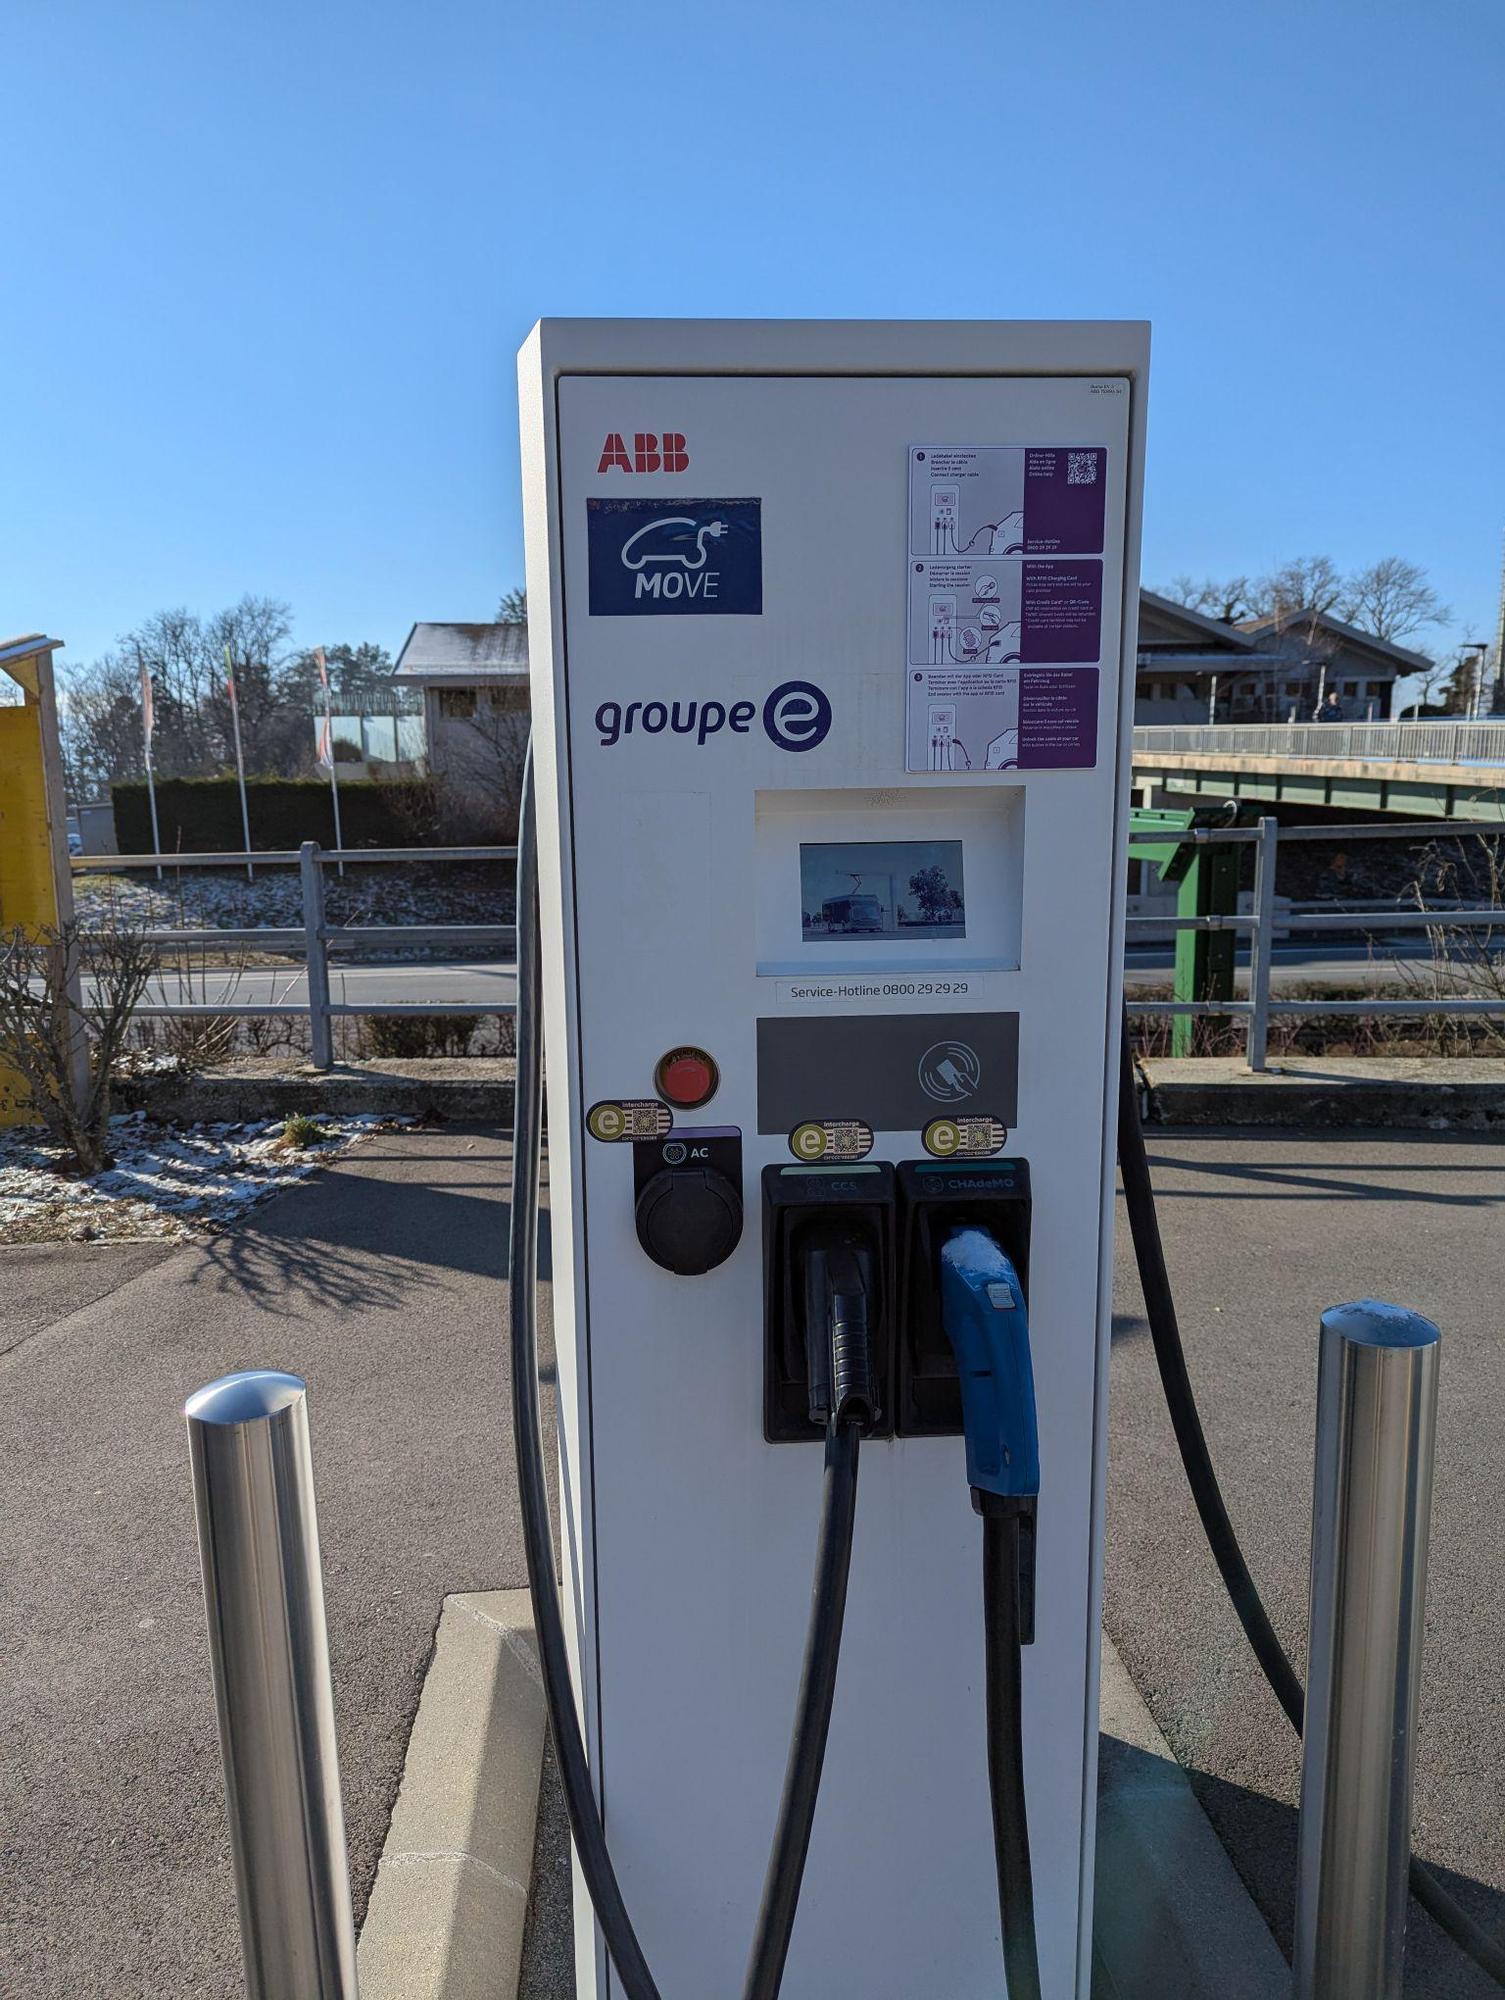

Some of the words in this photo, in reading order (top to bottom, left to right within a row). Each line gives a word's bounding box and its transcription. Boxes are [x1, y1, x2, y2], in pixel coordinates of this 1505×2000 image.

[597, 432, 690, 473] ABB
[634, 572, 720, 598] MOVE
[595, 701, 756, 746] groupe
[791, 984, 881, 998] Service-Hotline
[882, 983, 915, 995] 0800
[917, 983, 932, 995] 29
[935, 982, 950, 994] 29
[953, 982, 968, 994] 29
[691, 1148, 709, 1158] AC
[831, 1181, 857, 1191] CCS
[948, 1179, 1014, 1189] CHAdeMO
